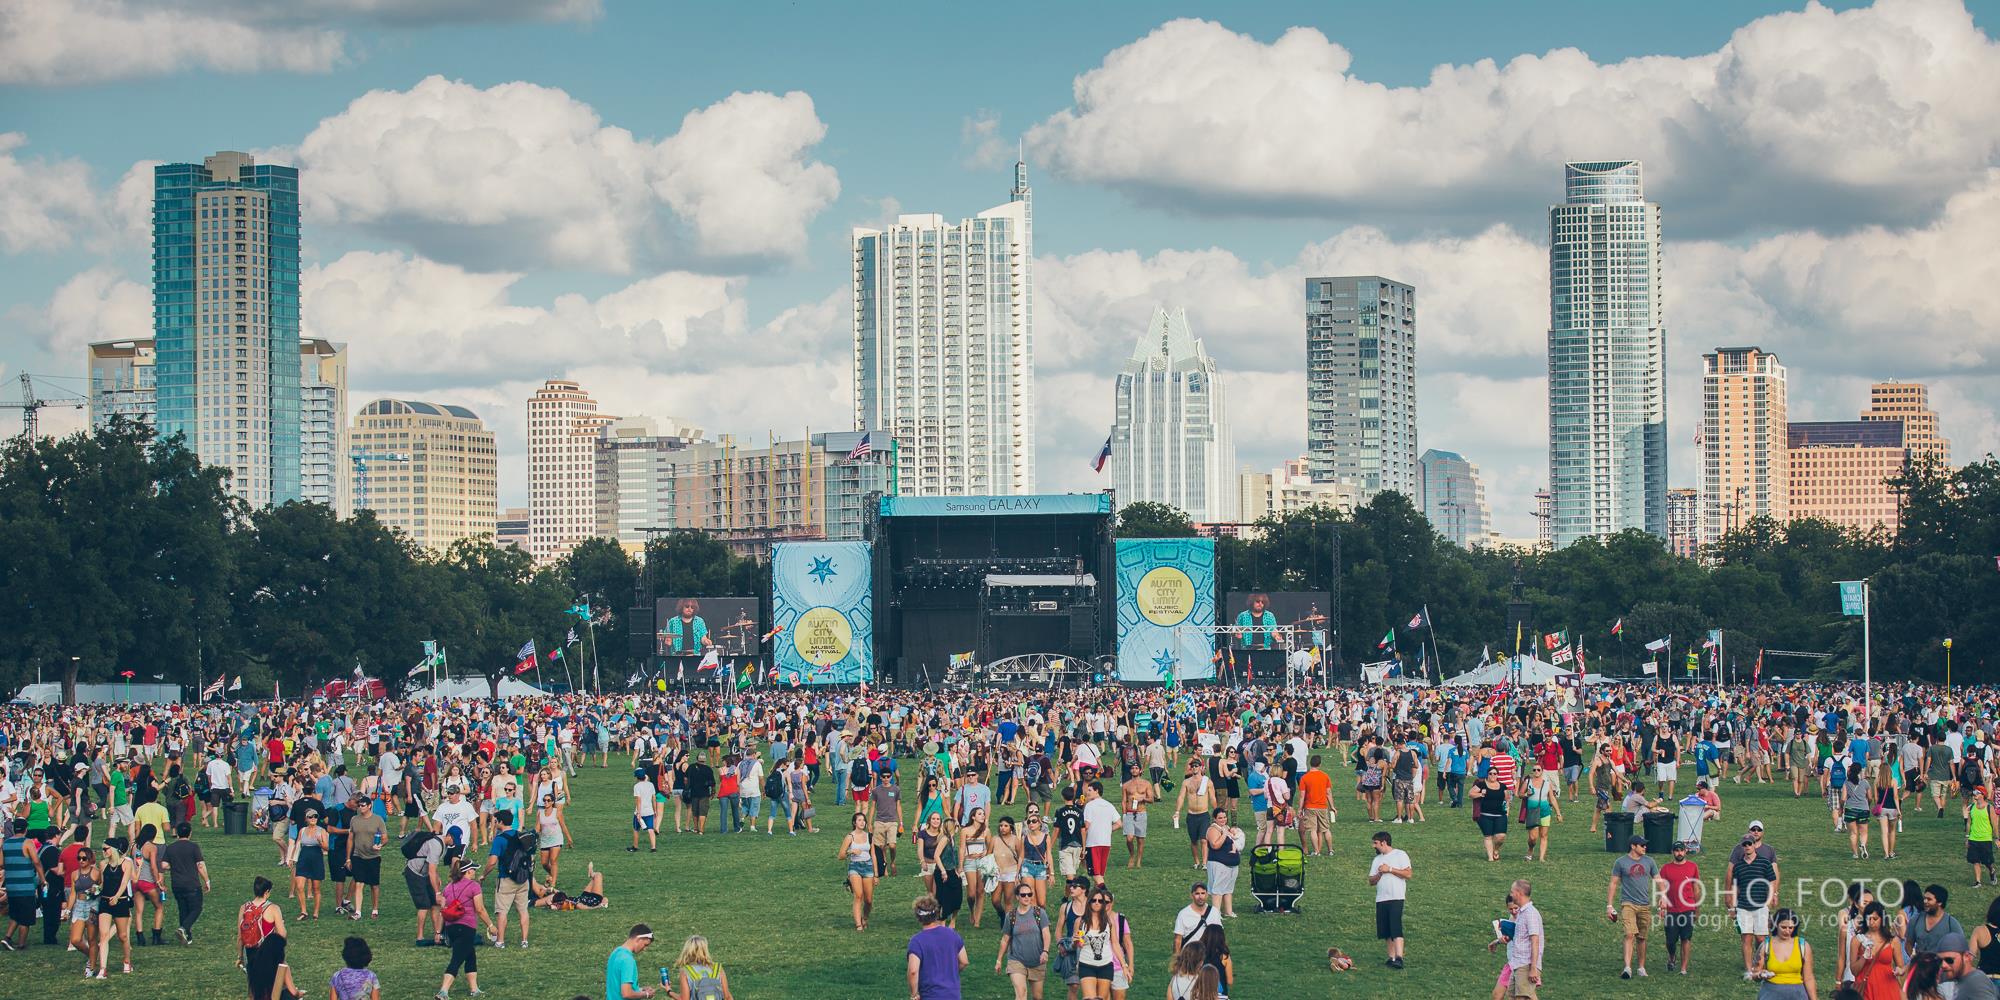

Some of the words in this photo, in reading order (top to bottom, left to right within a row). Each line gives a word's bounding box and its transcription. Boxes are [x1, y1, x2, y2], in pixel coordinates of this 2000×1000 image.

[946, 502, 985, 513] Samsung
[988, 498, 1041, 511] GALAXY
[1150, 579, 1182, 588] AUSTIN
[1157, 588, 1176, 596] CITY
[1152, 597, 1180, 605] LIMITS
[808, 620, 838, 628] AUSTIN
[813, 628, 833, 636] CITY
[809, 637, 837, 645] LIMITS
[1067, 817, 1076, 834] 9
